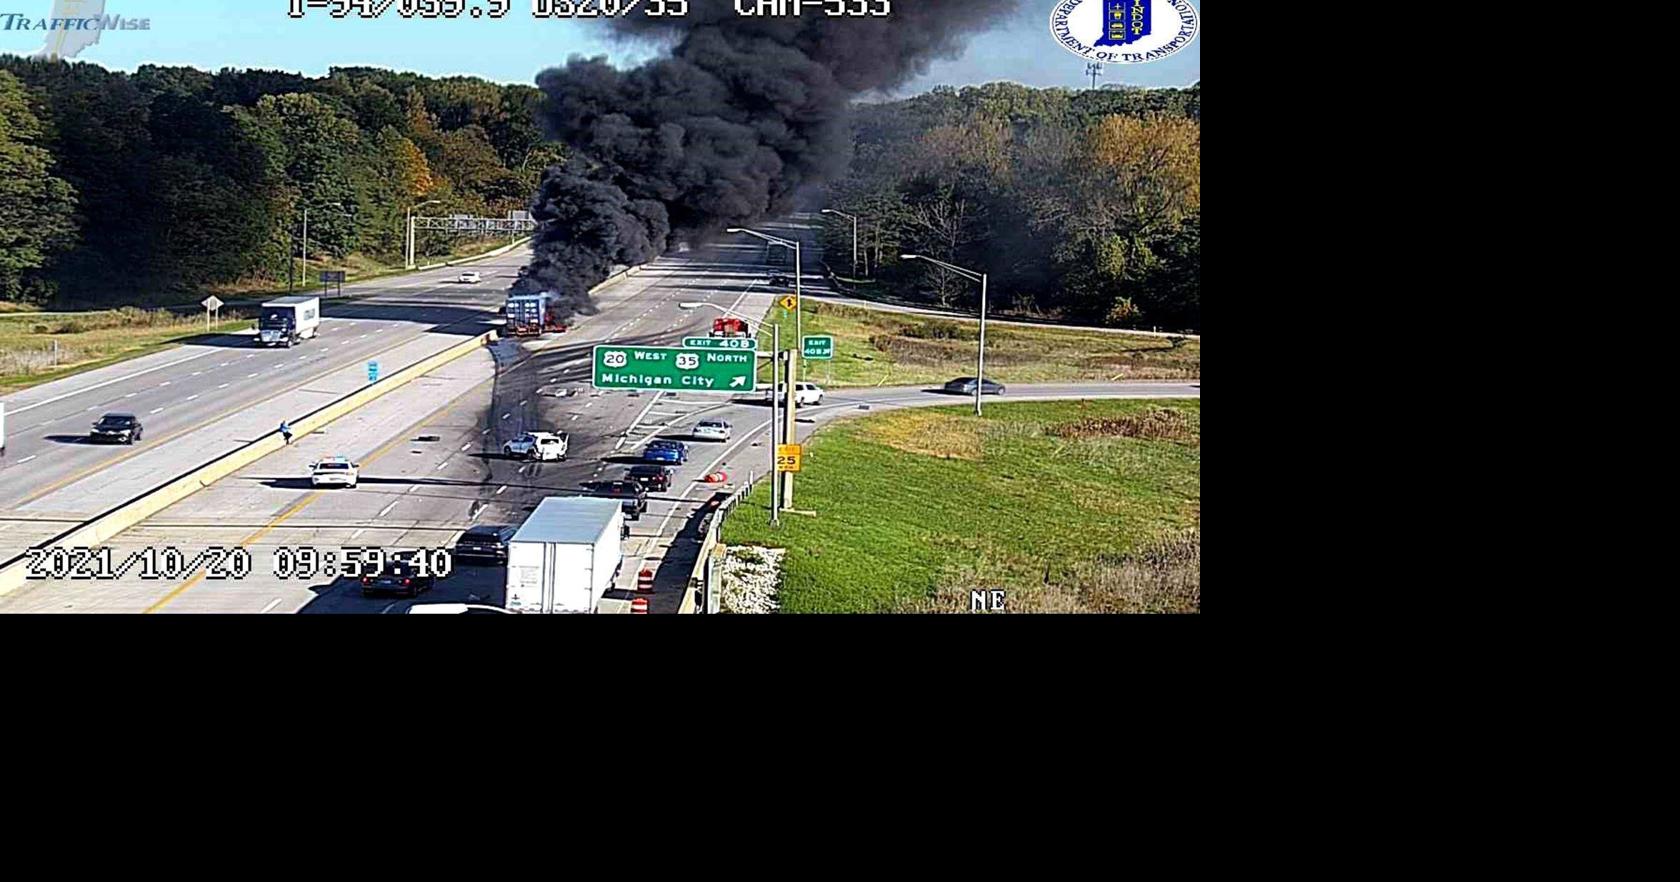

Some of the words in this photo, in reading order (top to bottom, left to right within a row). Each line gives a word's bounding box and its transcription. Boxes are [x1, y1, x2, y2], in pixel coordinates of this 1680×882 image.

[719, 339, 750, 348] 40B
[606, 354, 625, 364] 20
[634, 350, 667, 360] WEST
[678, 356, 697, 366] 35
[707, 353, 747, 363] NORTH
[602, 373, 672, 386] Michigan
[681, 375, 715, 387] City
[776, 455, 796, 465] 25
